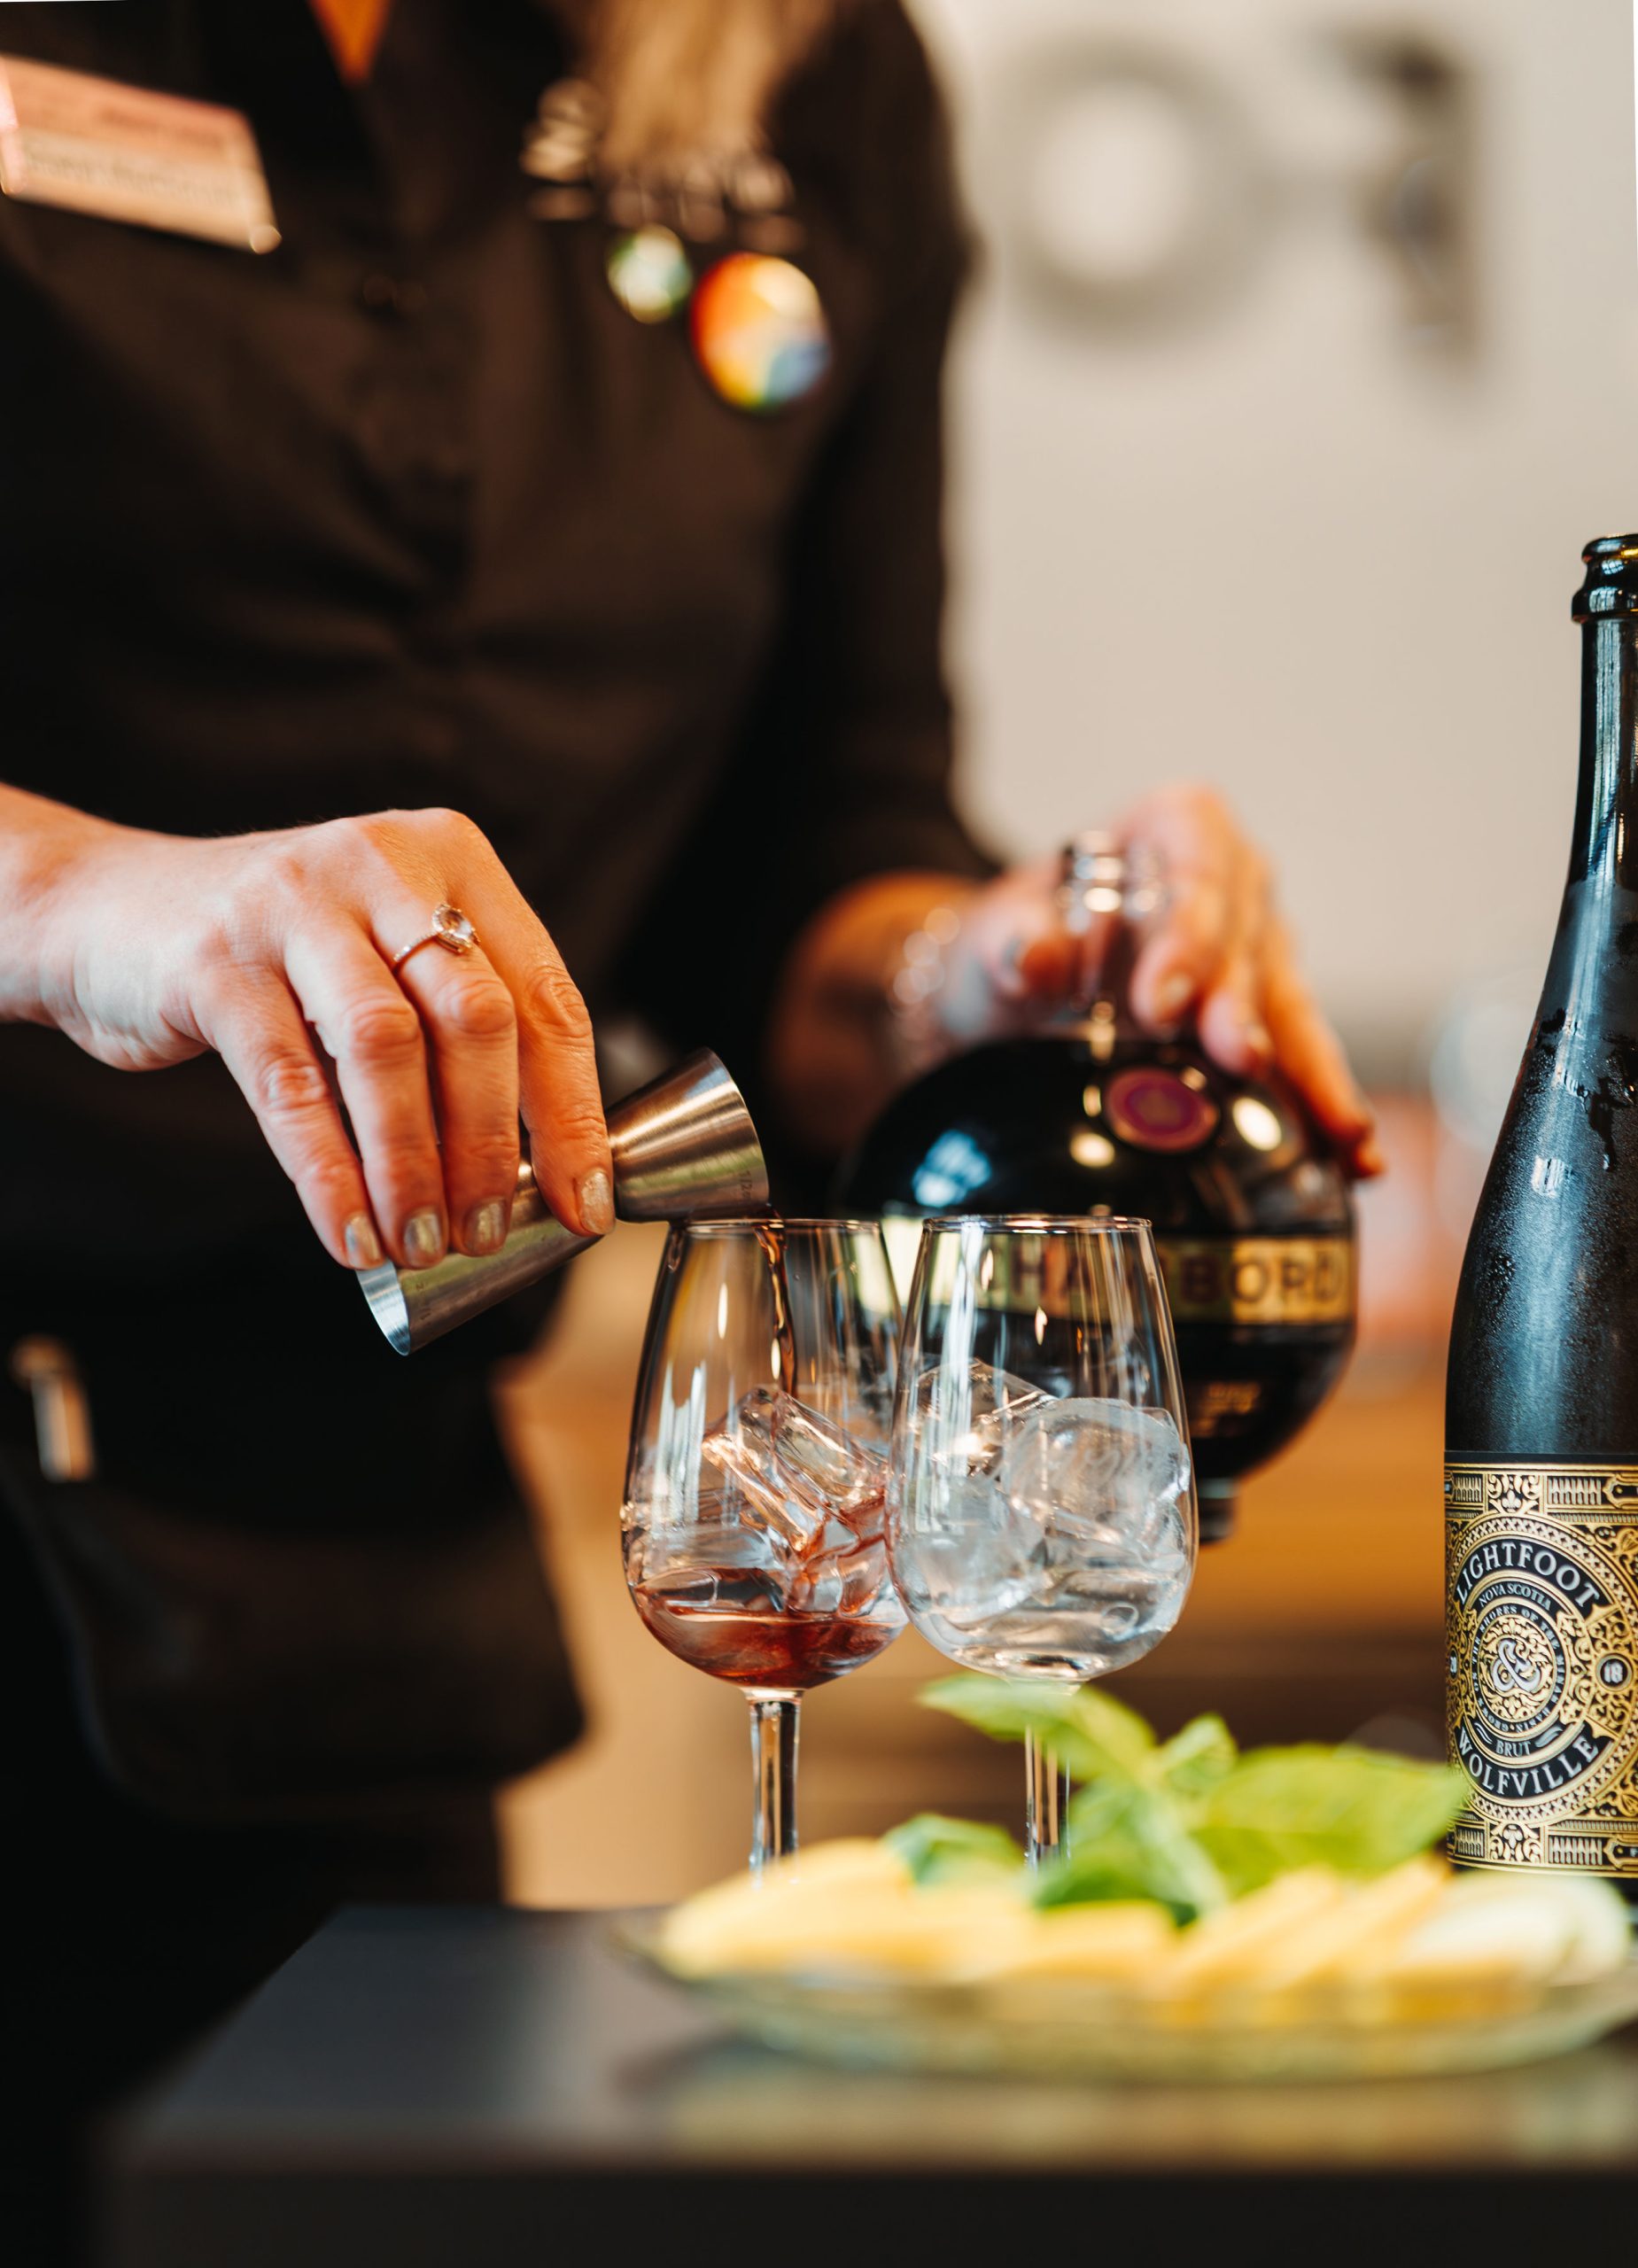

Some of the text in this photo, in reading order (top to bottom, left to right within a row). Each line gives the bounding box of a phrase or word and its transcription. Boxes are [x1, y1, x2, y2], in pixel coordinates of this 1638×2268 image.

[1456, 1542, 1600, 1608] LIGHTFOOT
[1479, 1582, 1551, 1612] NOVA SCOTIA
[1521, 1608, 1539, 1622] OF
[1458, 1726, 1599, 1797] WOLFVILLE
[1495, 1740, 1532, 1758] BRUT
